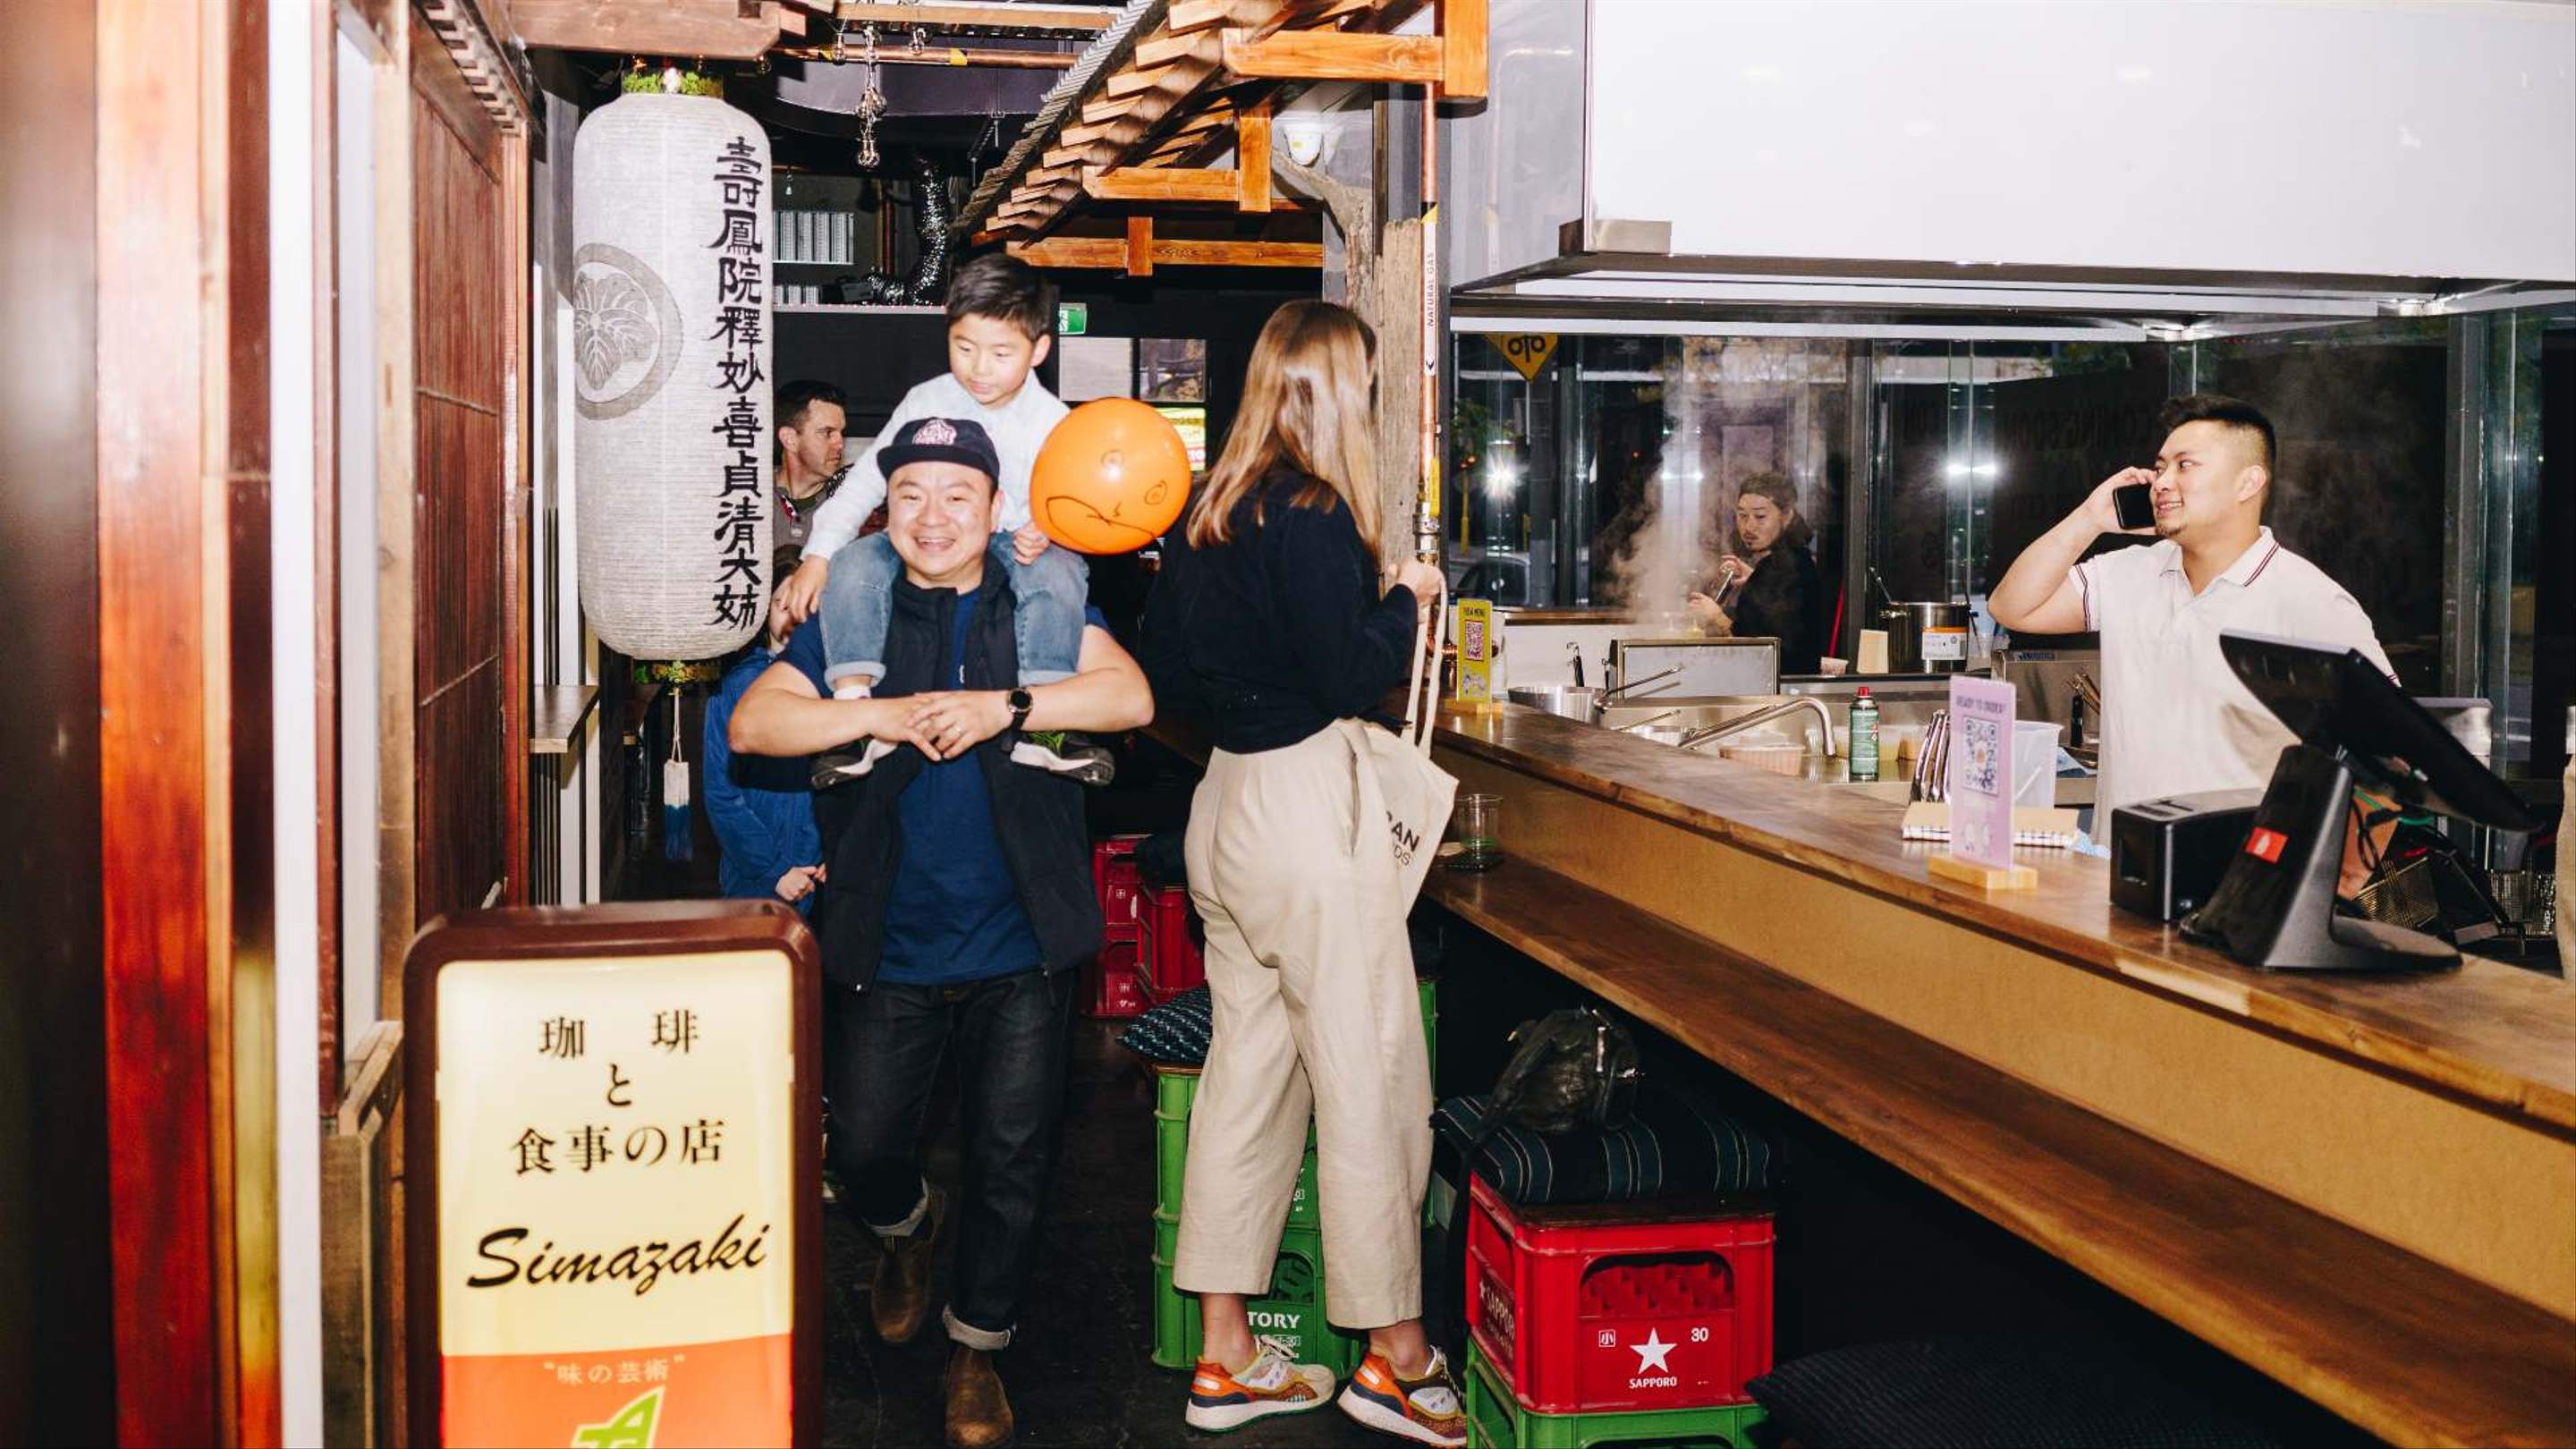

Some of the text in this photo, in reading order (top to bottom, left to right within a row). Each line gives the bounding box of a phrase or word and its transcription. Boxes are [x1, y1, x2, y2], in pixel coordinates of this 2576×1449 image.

[607, 1062, 632, 1107] と
[510, 1118, 726, 1175] 食事の店
[467, 1213, 771, 1296] Simazaki
[1690, 1326, 1709, 1343] 30
[1629, 1376, 1678, 1389] SAPPORO
